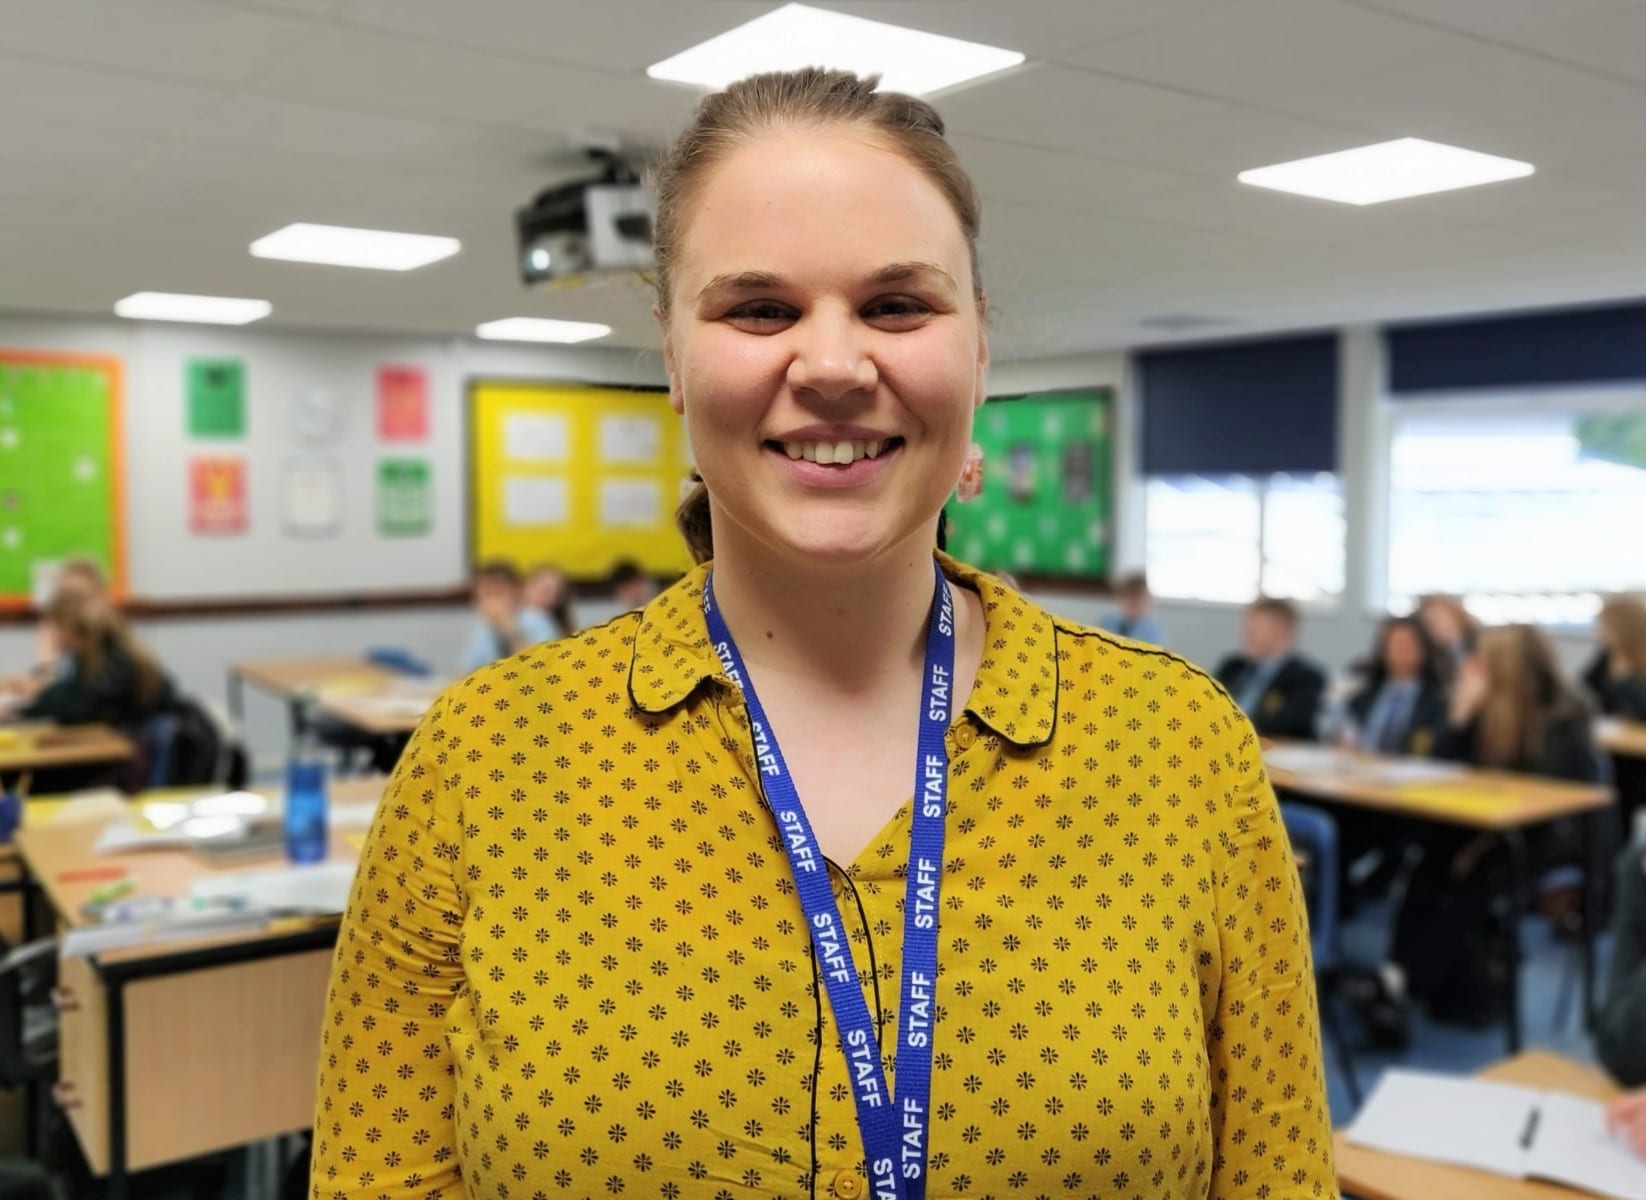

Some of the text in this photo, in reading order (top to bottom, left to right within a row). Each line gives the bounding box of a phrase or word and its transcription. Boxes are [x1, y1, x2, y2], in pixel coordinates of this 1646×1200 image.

[780, 811, 816, 873] STAFF
[813, 912, 849, 983] STAFF
[848, 1029, 881, 1107] STAFF
[902, 583, 953, 1179] STAFF STAFF STAFF STAFF STAFF STAFF
